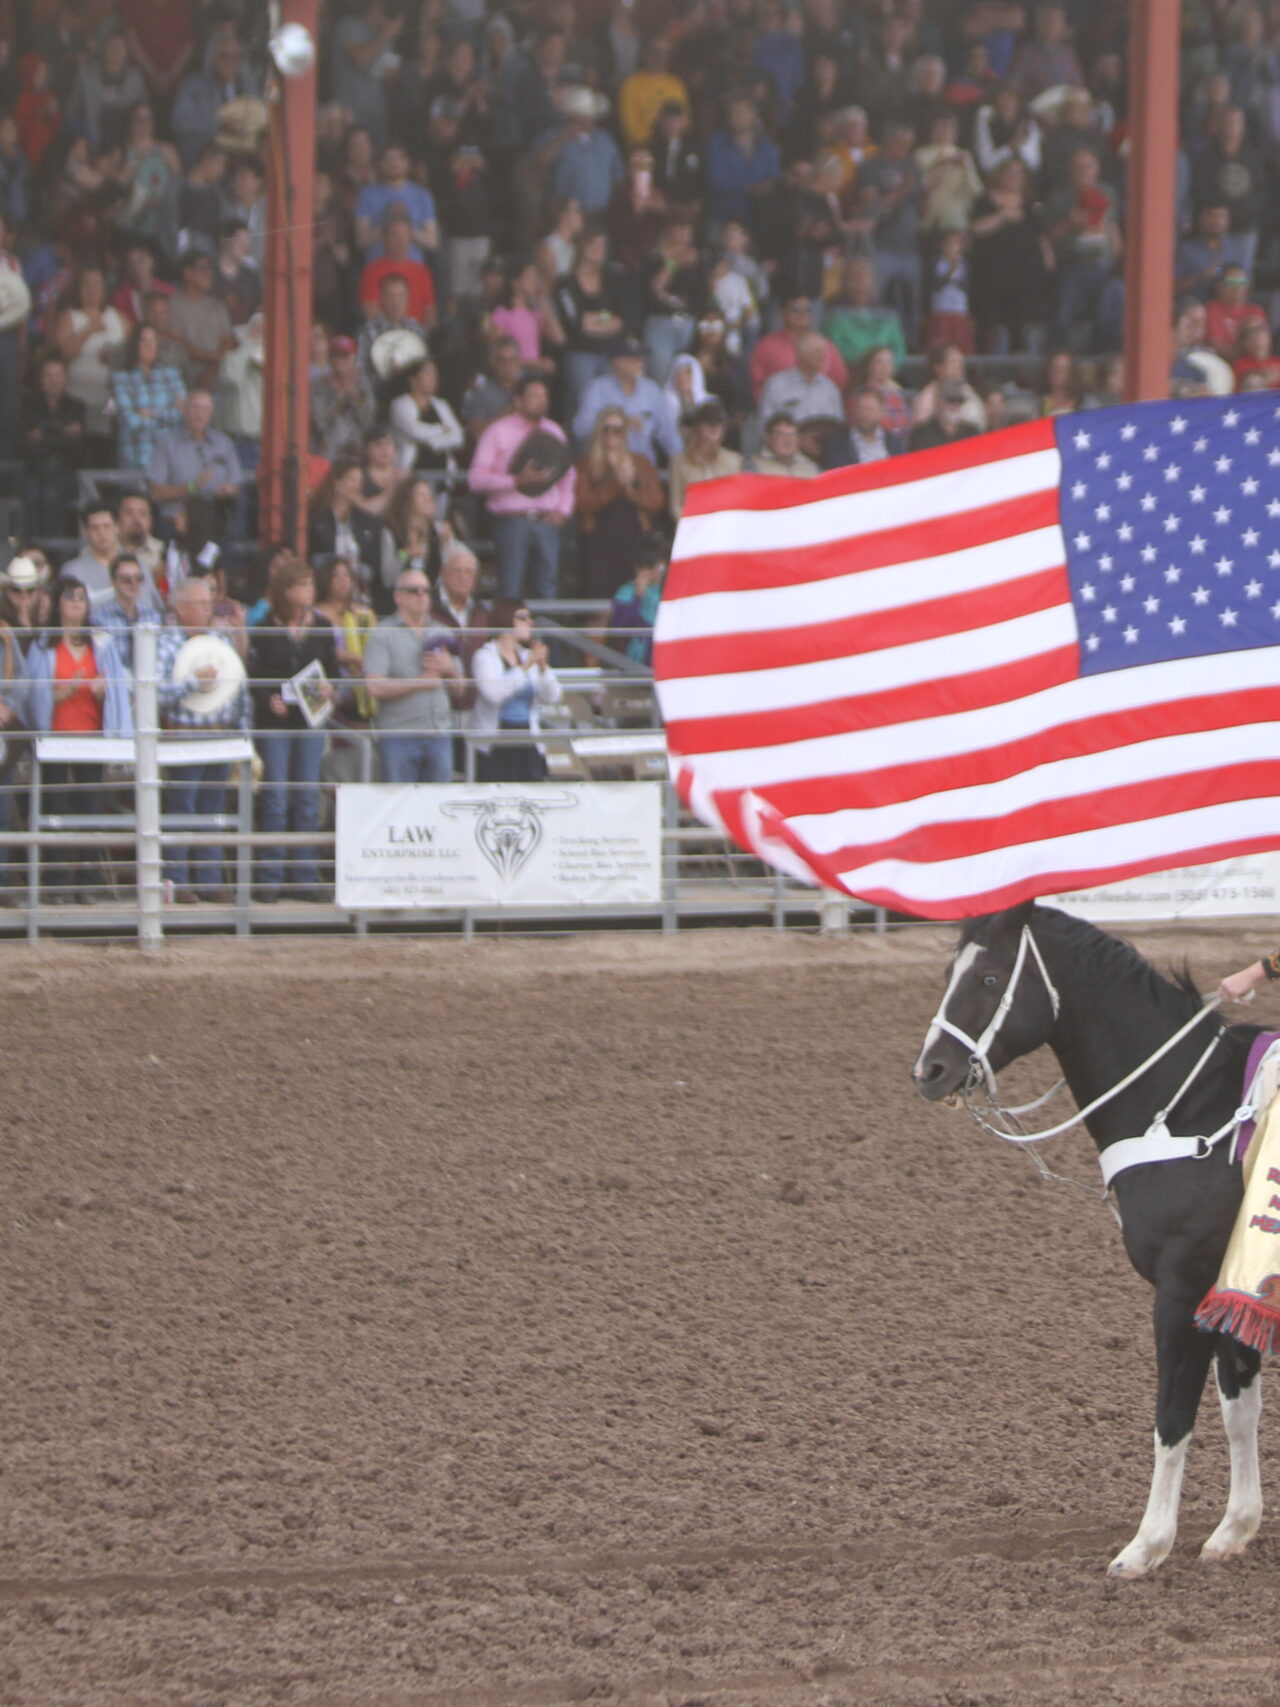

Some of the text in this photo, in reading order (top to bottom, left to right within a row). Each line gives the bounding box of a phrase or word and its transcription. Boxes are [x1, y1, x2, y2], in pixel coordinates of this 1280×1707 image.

[388, 825, 435, 843] LAW
[362, 849, 461, 858] ENTERPRISE LLC
